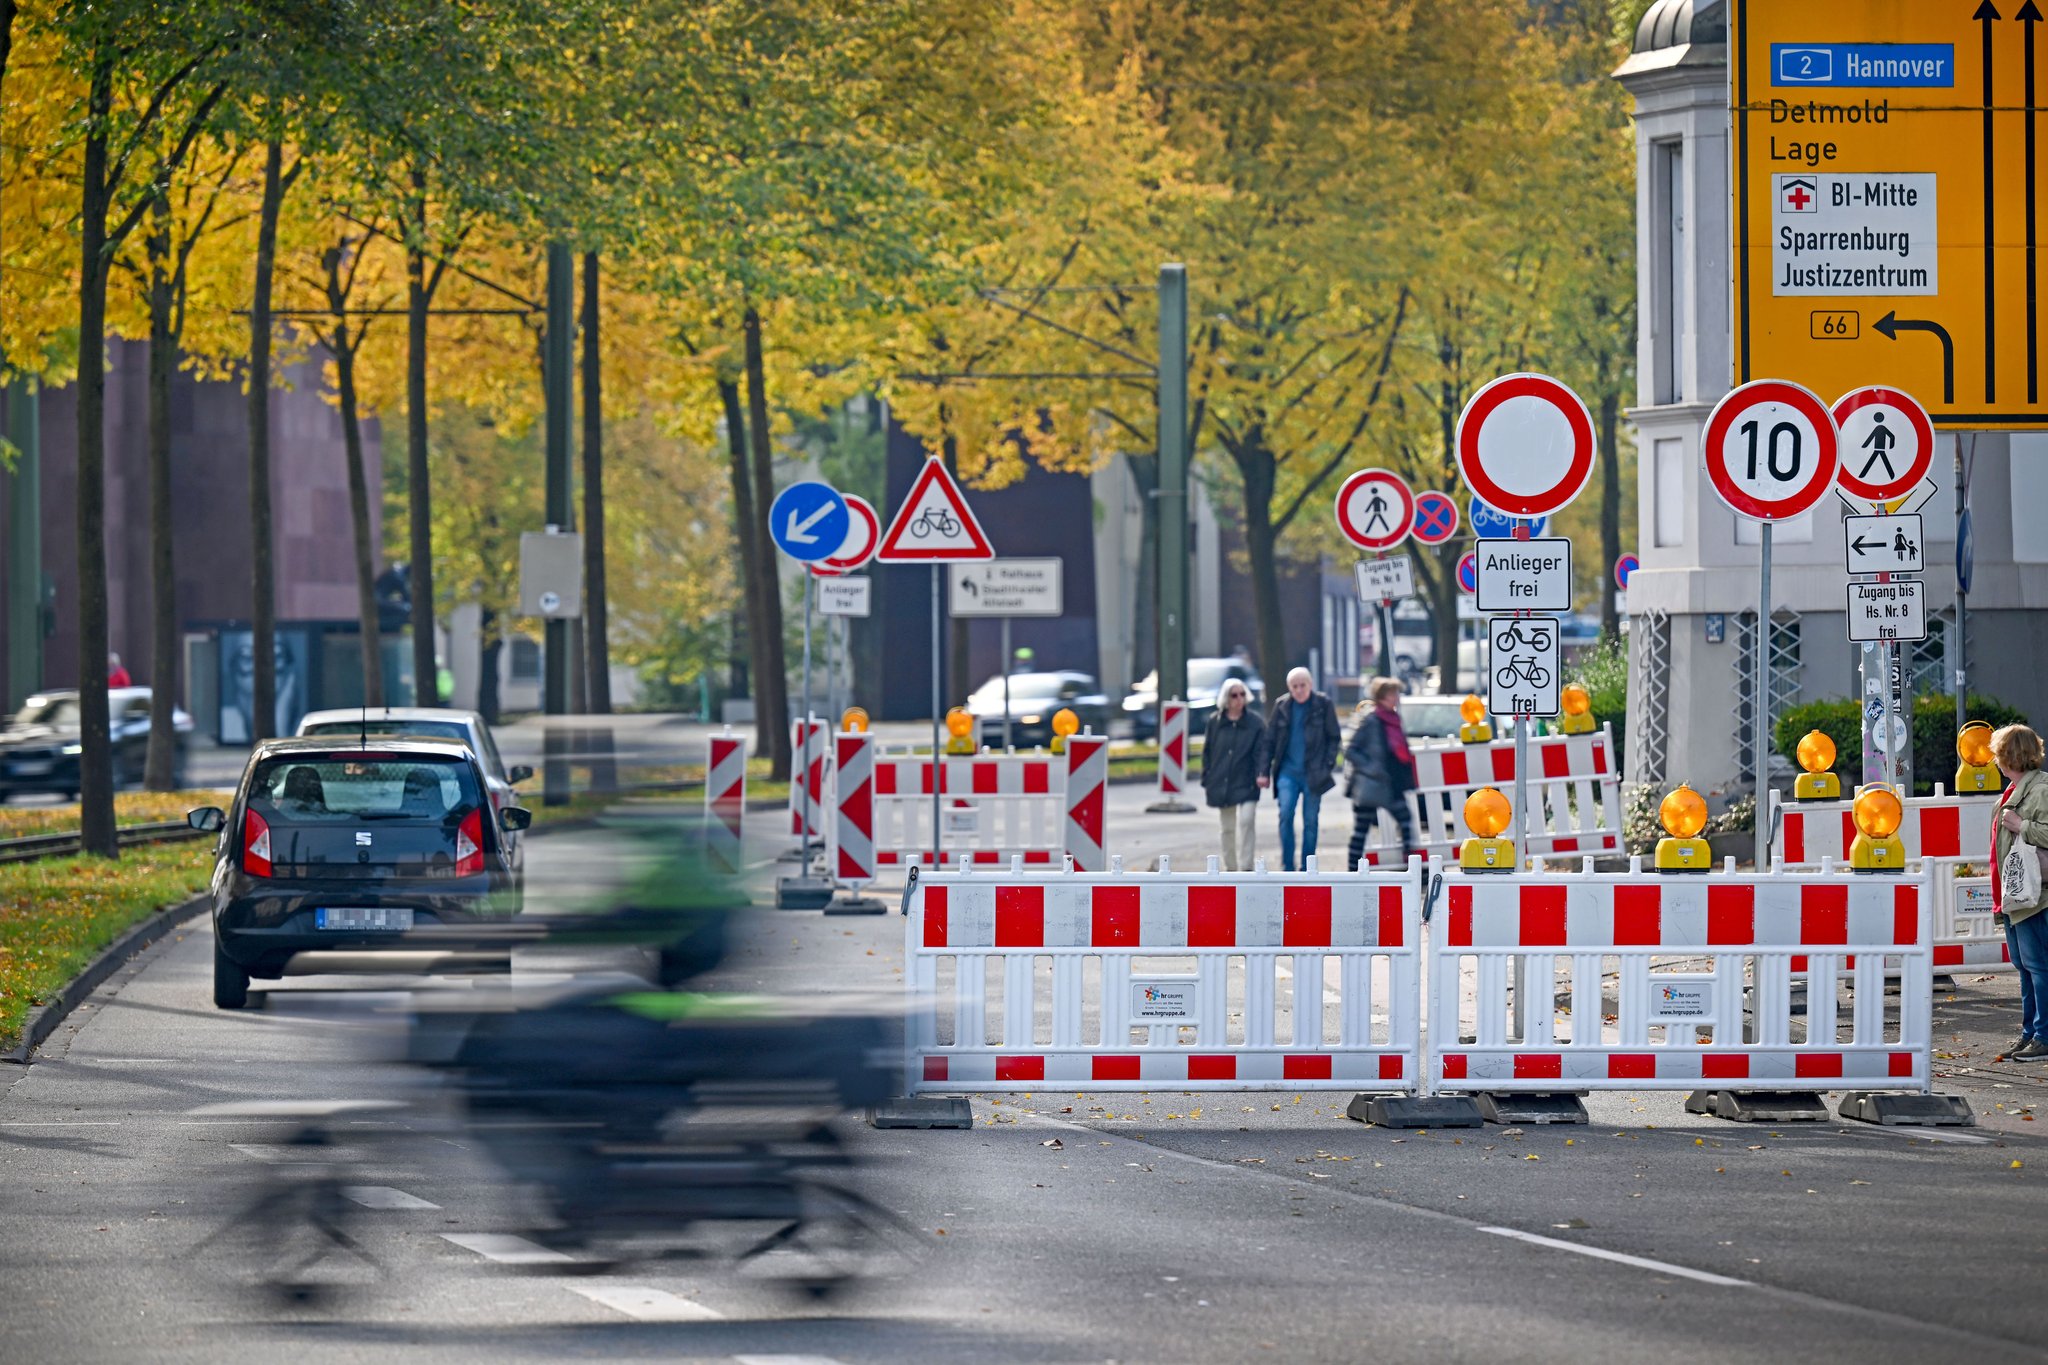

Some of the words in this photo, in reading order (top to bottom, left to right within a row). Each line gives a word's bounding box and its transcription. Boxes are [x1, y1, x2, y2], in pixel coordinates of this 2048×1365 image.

[1800, 56, 1812, 75] 2
[1846, 53, 1945, 78] Hannover
[1770, 98, 1889, 124] Detmold
[1770, 136, 1838, 166] Lage
[1831, 181, 1918, 207] BI-Mitte
[1780, 226, 1910, 257] Sparrenburg
[1780, 263, 1928, 288] Justizzentrum
[1822, 316, 1848, 335] 66
[1740, 420, 1802, 482] 10
[1485, 553, 1562, 575] Anlieger
[1509, 580, 1538, 597] frei
[1858, 585, 1896, 602] Zugang
[1898, 583, 1915, 597] bis
[1866, 604, 1882, 619] Hs.
[1885, 604, 1899, 618] Nr.
[1901, 603, 1909, 617] 8
[1879, 624, 1897, 638] frei
[1511, 693, 1537, 713] frei
